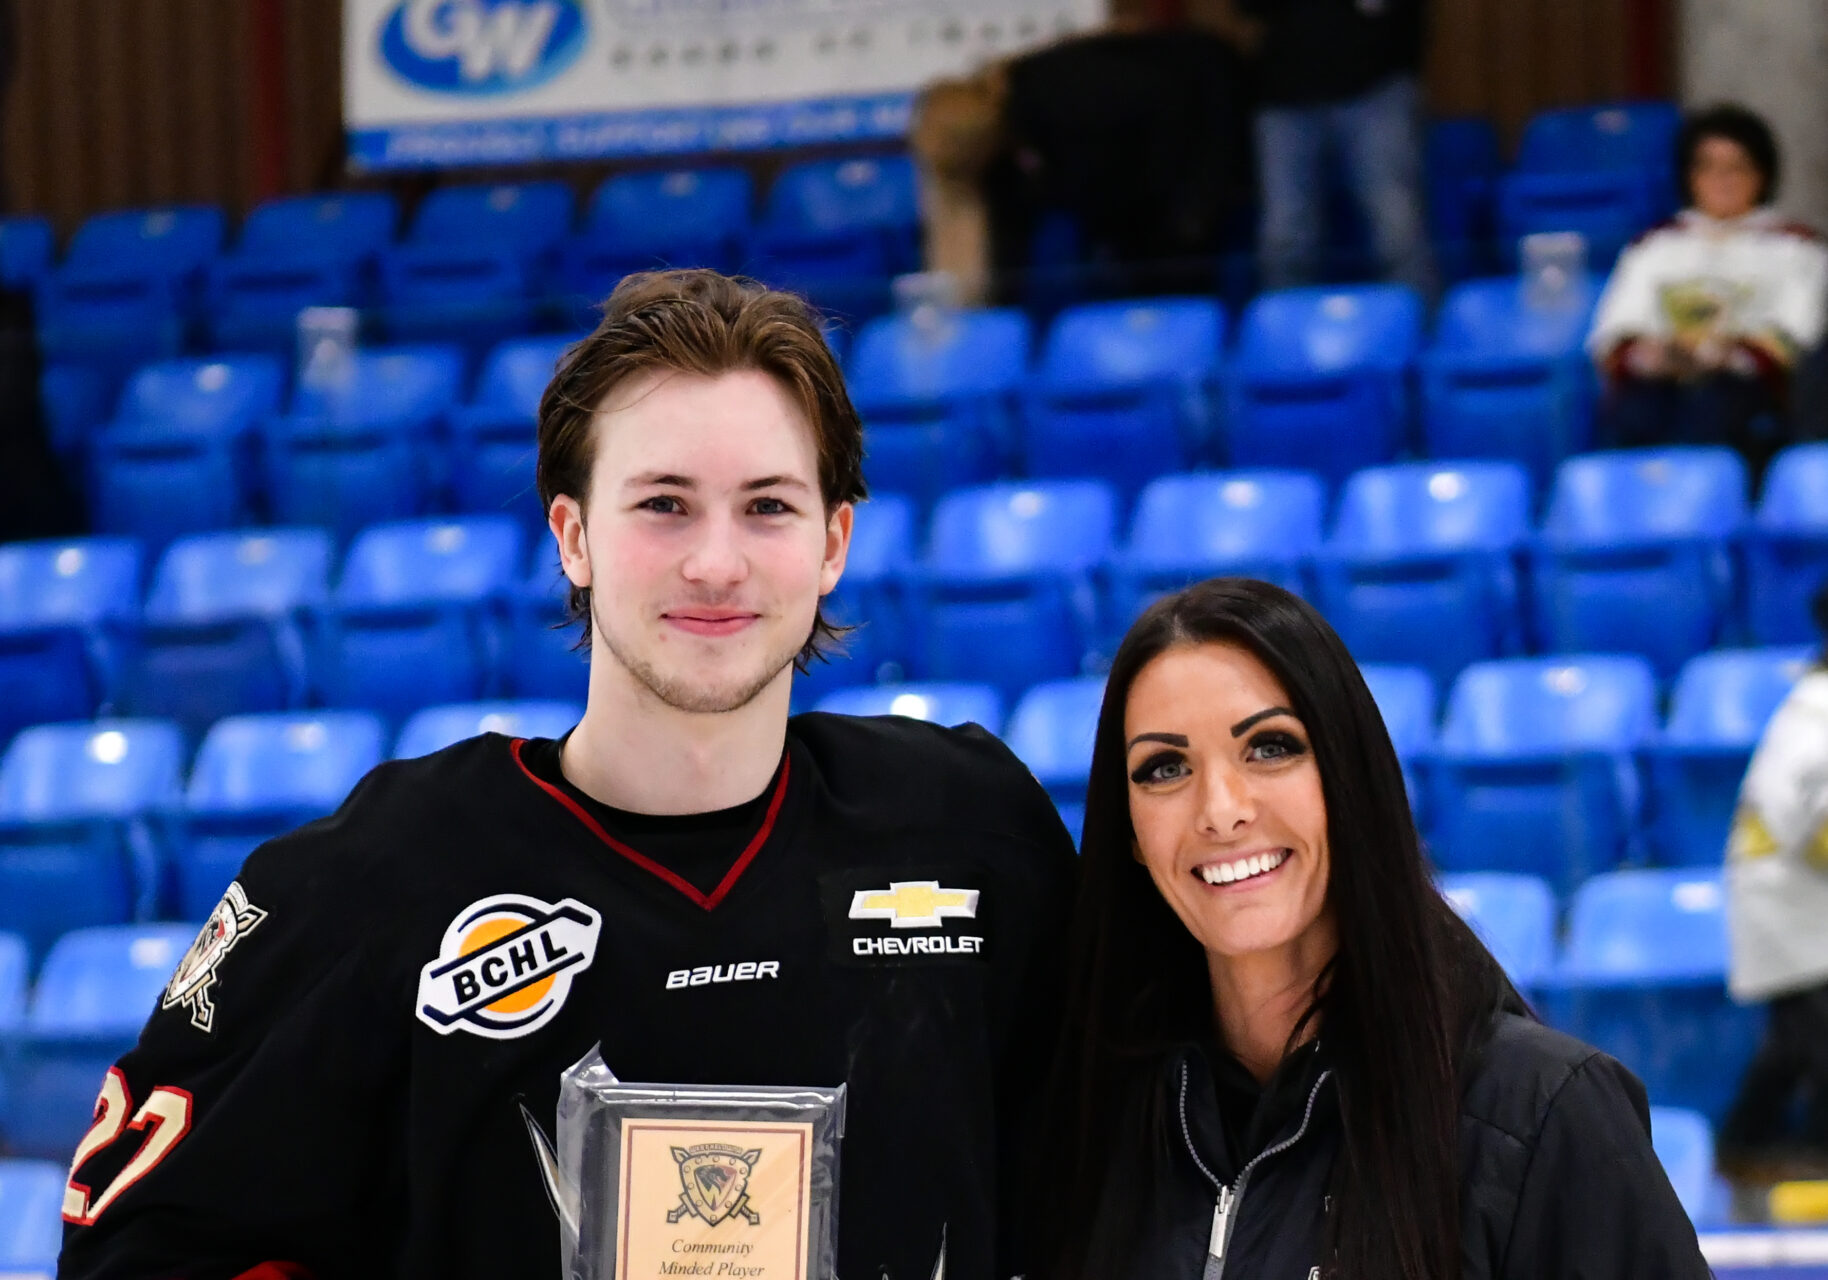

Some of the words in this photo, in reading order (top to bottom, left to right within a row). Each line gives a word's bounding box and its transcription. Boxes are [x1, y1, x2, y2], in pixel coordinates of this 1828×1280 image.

[852, 936, 984, 956] CHEVROLET
[452, 929, 568, 1006] BCHL
[665, 960, 780, 990] BAUER
[61, 1065, 193, 1226] 27
[671, 1239, 754, 1257] Community
[659, 1261, 714, 1276] Minded
[717, 1262, 765, 1279] Player
